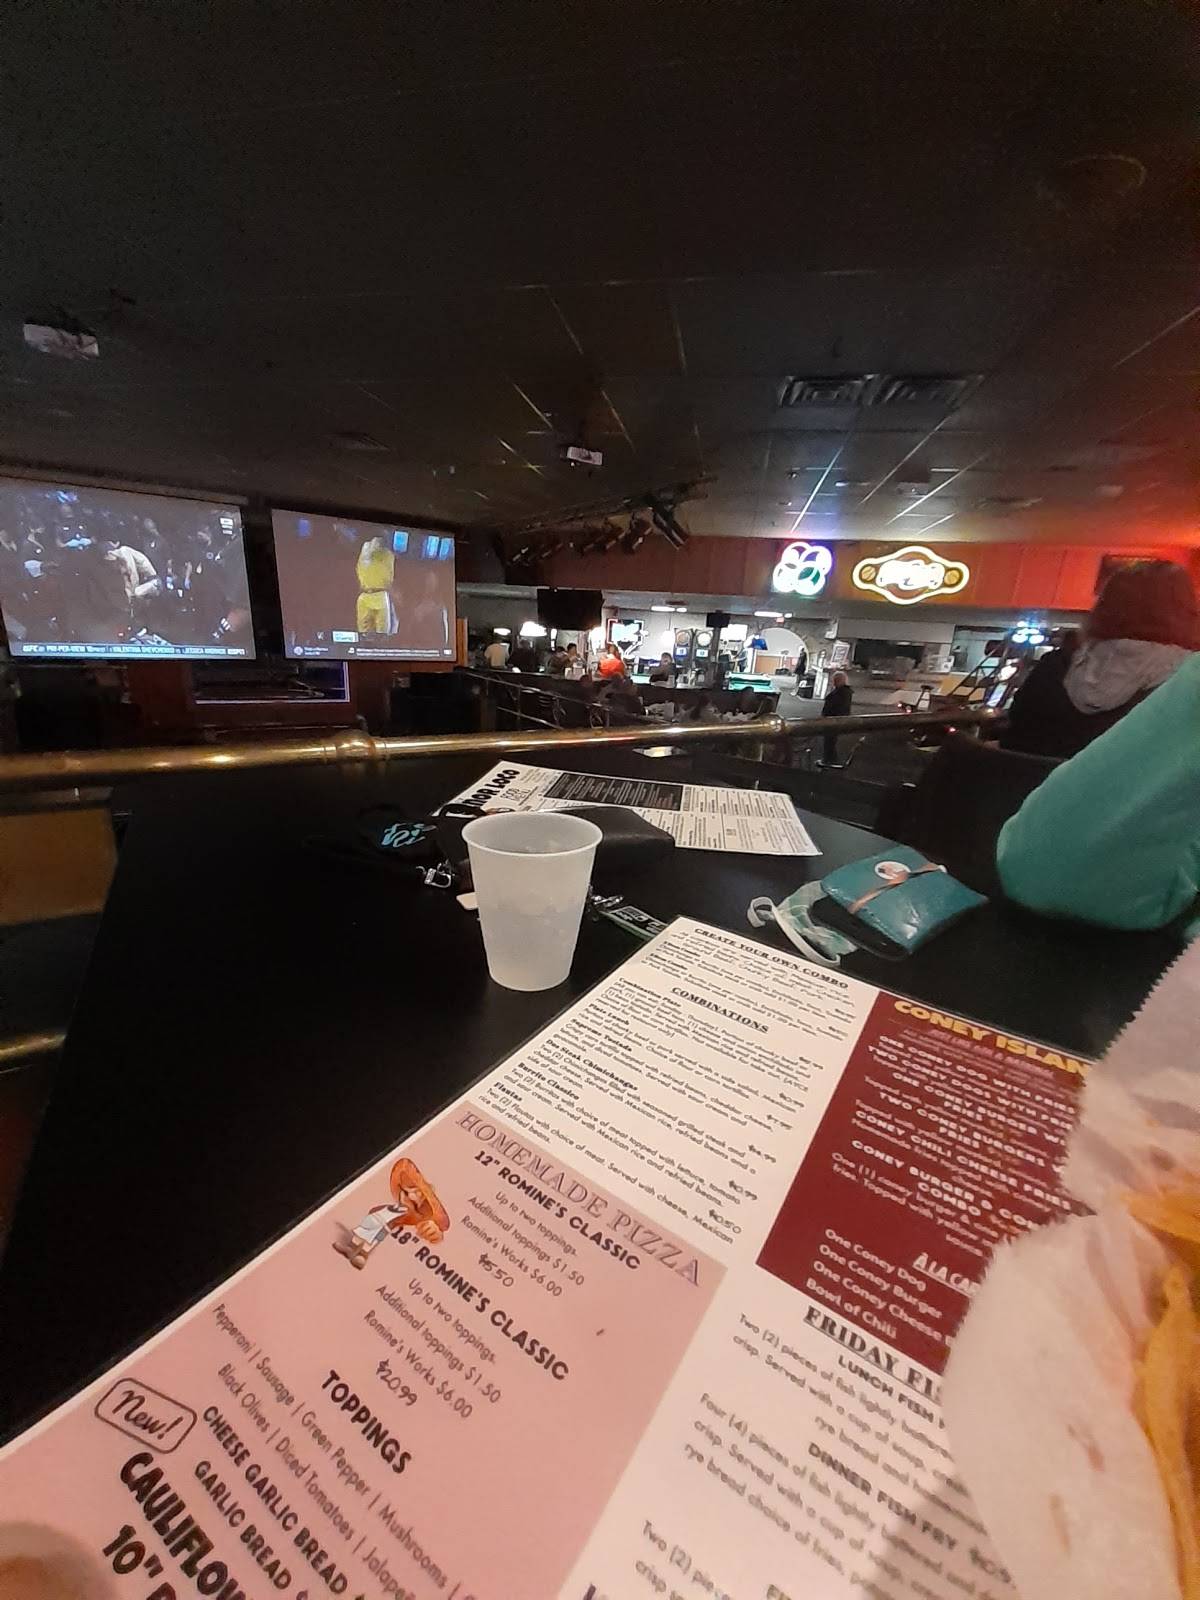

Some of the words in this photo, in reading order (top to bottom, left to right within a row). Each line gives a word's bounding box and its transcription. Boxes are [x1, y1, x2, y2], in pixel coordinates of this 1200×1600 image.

[694, 928, 736, 946] CREATE
[738, 943, 769, 959] YOUR
[771, 956, 799, 970] OWN
[802, 968, 848, 989] COMBO
[671, 987, 768, 1033] COMBINATIONS
[893, 1000, 991, 1040] CONEY
[493, 1081, 522, 1101] Flautas
[517, 1062, 546, 1081] Burrito
[546, 1079, 580, 1100] Classico
[560, 1047, 581, 1061] Steak
[582, 1059, 638, 1091] Chimichangas
[868, 1045, 898, 1061] TWO
[901, 1059, 947, 1080] CONEY
[996, 1096, 1036, 1116] WITH
[907, 1046, 952, 1066] CONEY
[992, 1078, 1031, 1097] WITH
[504, 1112, 530, 1128] refried
[527, 1124, 550, 1144] beans.
[879, 1091, 912, 1110] TWO
[916, 1108, 967, 1133] CONEY
[972, 1131, 1045, 1167] BURGERS
[892, 1072, 919, 1087] ONE
[924, 1085, 972, 1108] CONEY
[977, 1106, 1037, 1134] BURGER
[943, 1100, 982, 1121] FRIES
[831, 1152, 856, 1168] One
[855, 1110, 905, 1136] CONEY
[910, 1135, 951, 1157] CHILI
[956, 1155, 1017, 1187] CHEESE
[1023, 1183, 1071, 1210] FRIES
[939, 1126, 979, 1148] FRIES
[455, 1111, 608, 1218] HOMEMADE
[606, 1209, 698, 1287] PIZZA
[510, 1102, 535, 1121] Flautas
[550, 1129, 574, 1146] choice
[607, 1162, 638, 1184] Served
[638, 1182, 655, 1196] with
[656, 1194, 688, 1218] cheese,
[692, 1215, 733, 1244] Mexican
[851, 1140, 904, 1168] CONEY
[909, 1166, 974, 1202] BURGER
[917, 1182, 981, 1216] COMBO
[467, 1196, 514, 1232] Additional
[511, 1228, 551, 1262] toppings
[474, 1150, 500, 1166] 12"
[497, 1166, 568, 1218] ROMINE'S
[569, 1215, 640, 1269] CLASSIC
[495, 1191, 509, 1205] Up
[518, 1209, 536, 1225] two
[536, 1222, 577, 1256] toppings.
[460, 1215, 498, 1249] Romine's
[500, 1243, 529, 1273] Works
[825, 1228, 851, 1249] One
[853, 1244, 895, 1274] Coney
[897, 1267, 926, 1292] Dog
[927, 1261, 948, 1282] LA
[390, 1224, 420, 1245] 18"
[414, 1245, 490, 1313] ROMINE'S
[490, 1310, 569, 1380] CLASSIC
[806, 1277, 841, 1305] Bowl
[843, 1302, 861, 1316] of
[862, 1310, 896, 1339] Chili
[813, 1260, 841, 1282] One
[842, 1277, 887, 1309] Coney
[888, 1303, 942, 1341] Cheese
[819, 1244, 846, 1265] One
[847, 1260, 891, 1291] Coney
[892, 1284, 942, 1319] Burger
[375, 1285, 426, 1331] Additional
[421, 1327, 464, 1372] toppings
[408, 1277, 423, 1296] Up
[432, 1302, 452, 1322] two
[451, 1318, 495, 1364] toppings.
[739, 1313, 760, 1334] Two
[761, 1329, 780, 1348] (2)
[780, 1344, 817, 1372] pieces
[804, 1305, 898, 1374] FRIDAY
[363, 1309, 404, 1354] Romine's
[405, 1348, 436, 1386] Works
[435, 1380, 473, 1418] $6.00
[375, 1358, 418, 1406] $20.99
[838, 1355, 894, 1397] LUNCH
[897, 1392, 934, 1423] FISH
[112, 1389, 184, 1440] New!
[212, 1303, 252, 1354] Pepperoni
[255, 1356, 295, 1406] Sausage
[301, 1410, 333, 1453] Green
[330, 1446, 370, 1496] Pepper
[377, 1503, 448, 1590] Mushrooms
[321, 1369, 412, 1474] TOPPINGS
[699, 1392, 727, 1418] Four
[728, 1413, 748, 1437] (4)
[748, 1433, 789, 1467] pieces
[217, 1363, 246, 1397] Black
[240, 1392, 270, 1433] Olives
[274, 1436, 311, 1479] Diced
[304, 1470, 354, 1541] Tomatoes
[808, 1442, 872, 1495] DINNER
[877, 1490, 917, 1527] FISH
[194, 1460, 245, 1527] GARLIC
[239, 1524, 292, 1590] BREAD
[203, 1405, 251, 1467] CHEESE
[244, 1463, 298, 1531] GARLIC
[293, 1526, 348, 1595] BREAD
[102, 1524, 164, 1579] 10"
